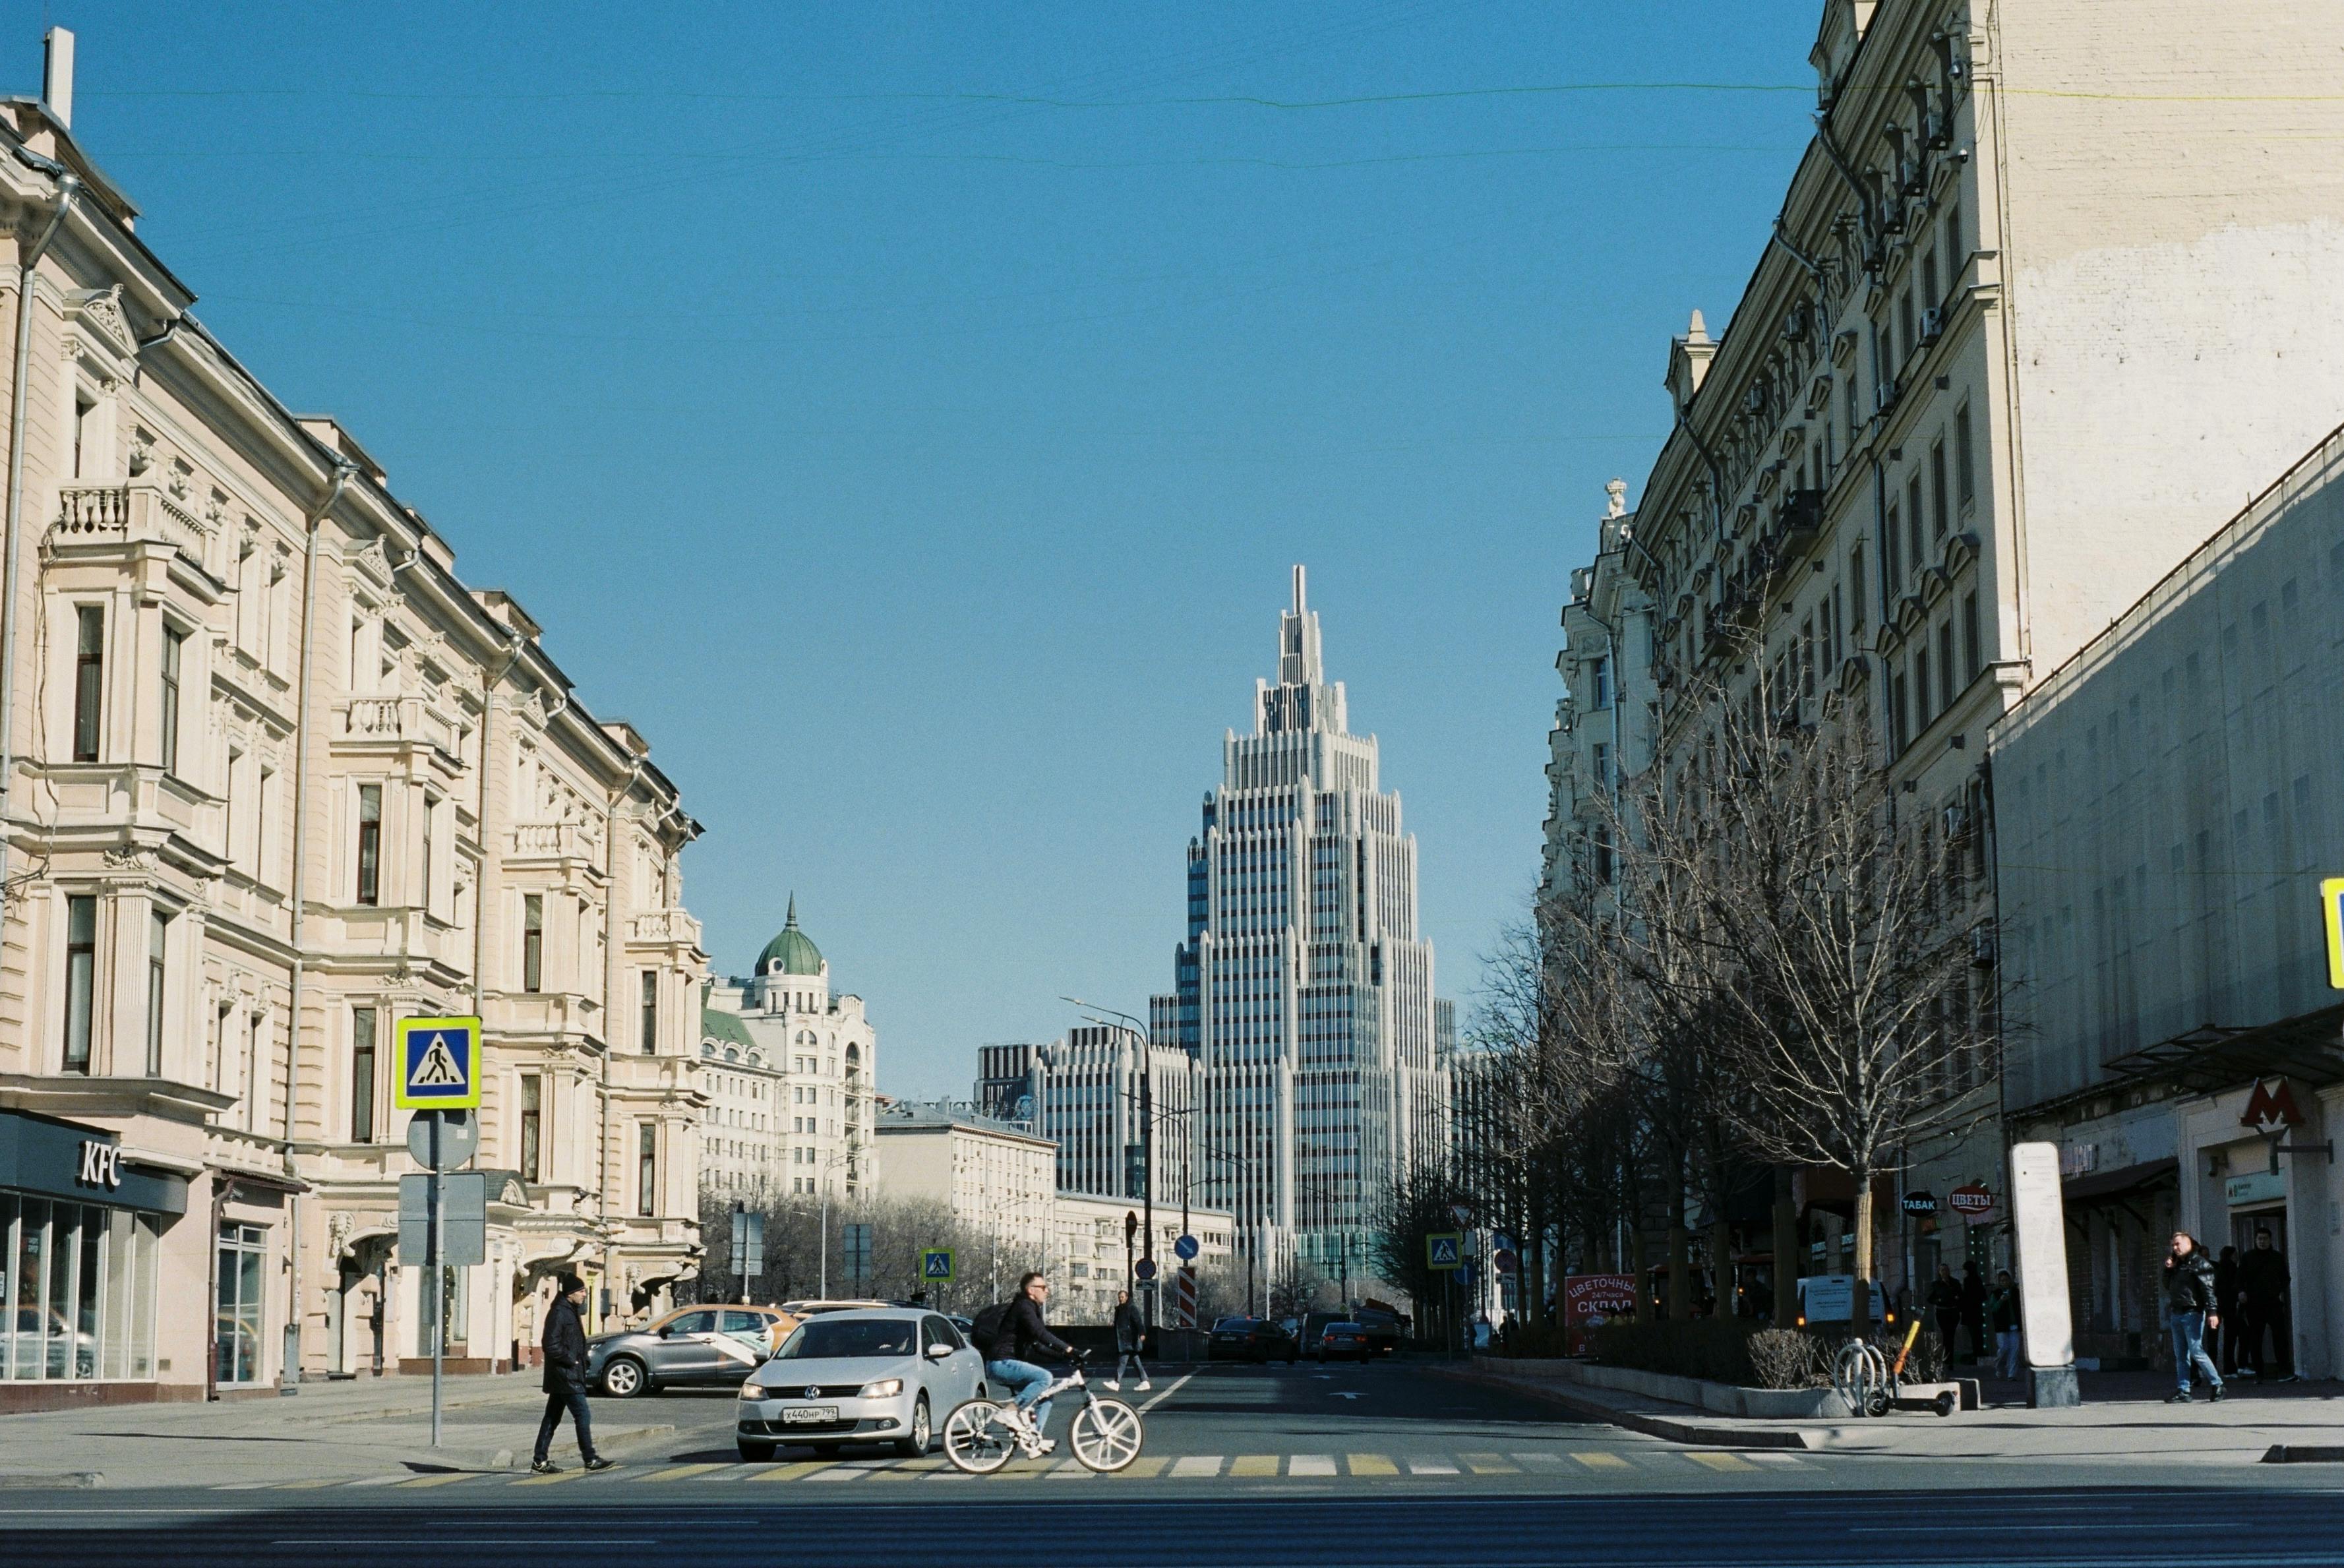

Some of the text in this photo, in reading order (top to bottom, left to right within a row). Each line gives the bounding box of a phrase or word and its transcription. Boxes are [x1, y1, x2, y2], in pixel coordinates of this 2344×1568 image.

[82, 1140, 122, 1186] KFC
[1902, 1199, 1935, 1210] ТАБАК
[1951, 1194, 1991, 1206] ЦВЕТЫ
[1569, 1278, 1636, 1298] ЦВЕТОЧНЫ
